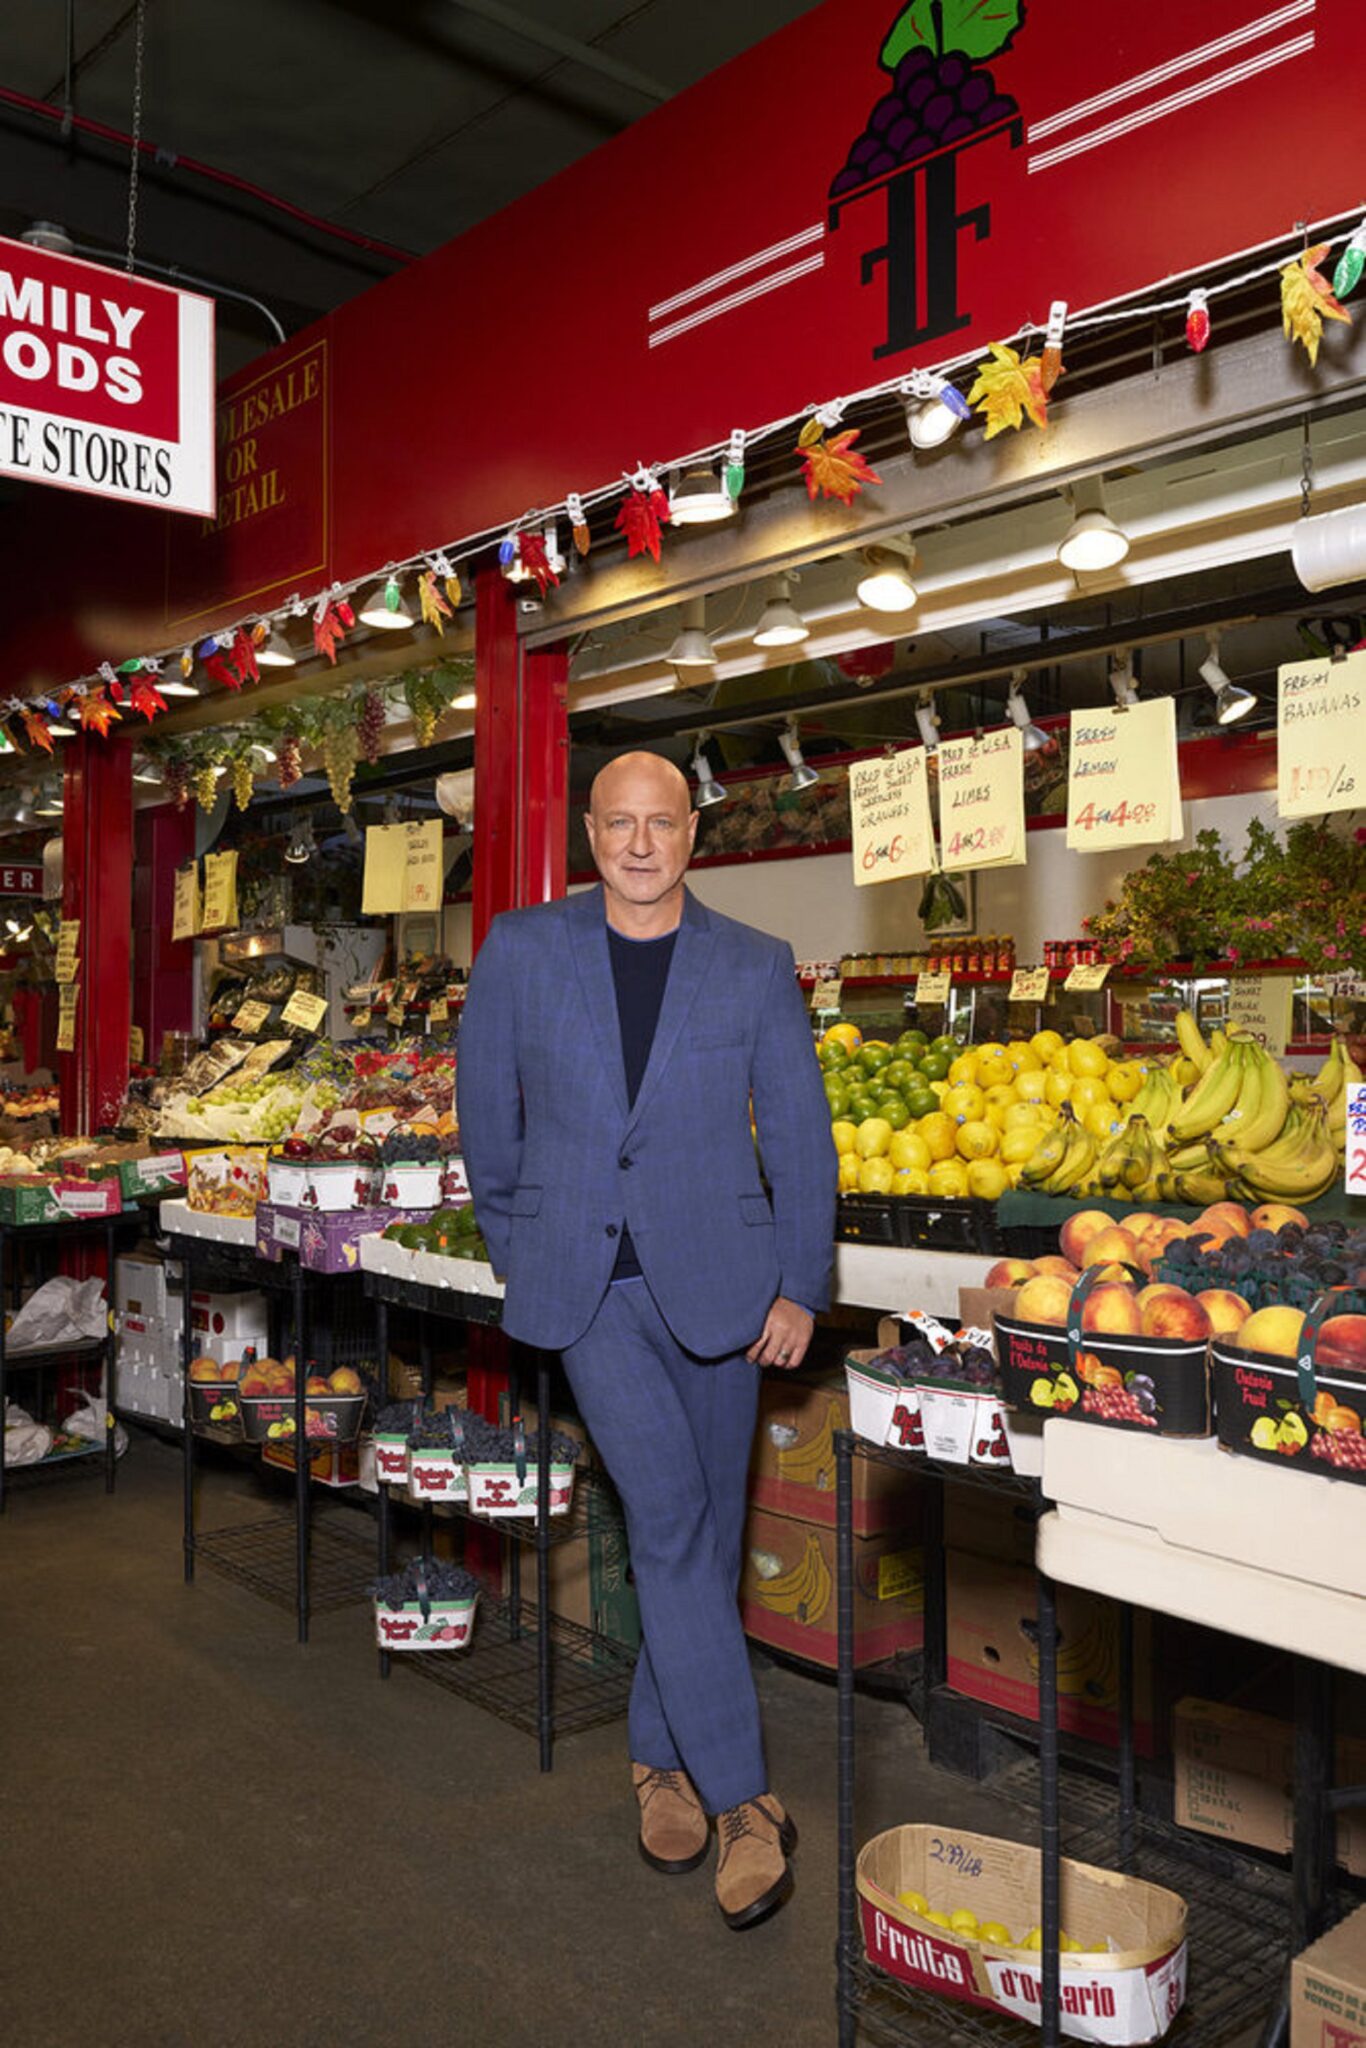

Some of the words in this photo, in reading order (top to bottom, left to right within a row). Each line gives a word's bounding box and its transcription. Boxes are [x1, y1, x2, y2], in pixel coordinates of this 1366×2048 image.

[3, 330, 144, 405] ODS
[42, 422, 172, 498] STORES
[226, 438, 258, 483] OR
[1284, 693, 1360, 723] BANANAS
[1073, 758, 1118, 777] LEMON
[951, 785, 991, 808] LIMES
[999, 1967, 1115, 2018] d'Oario
